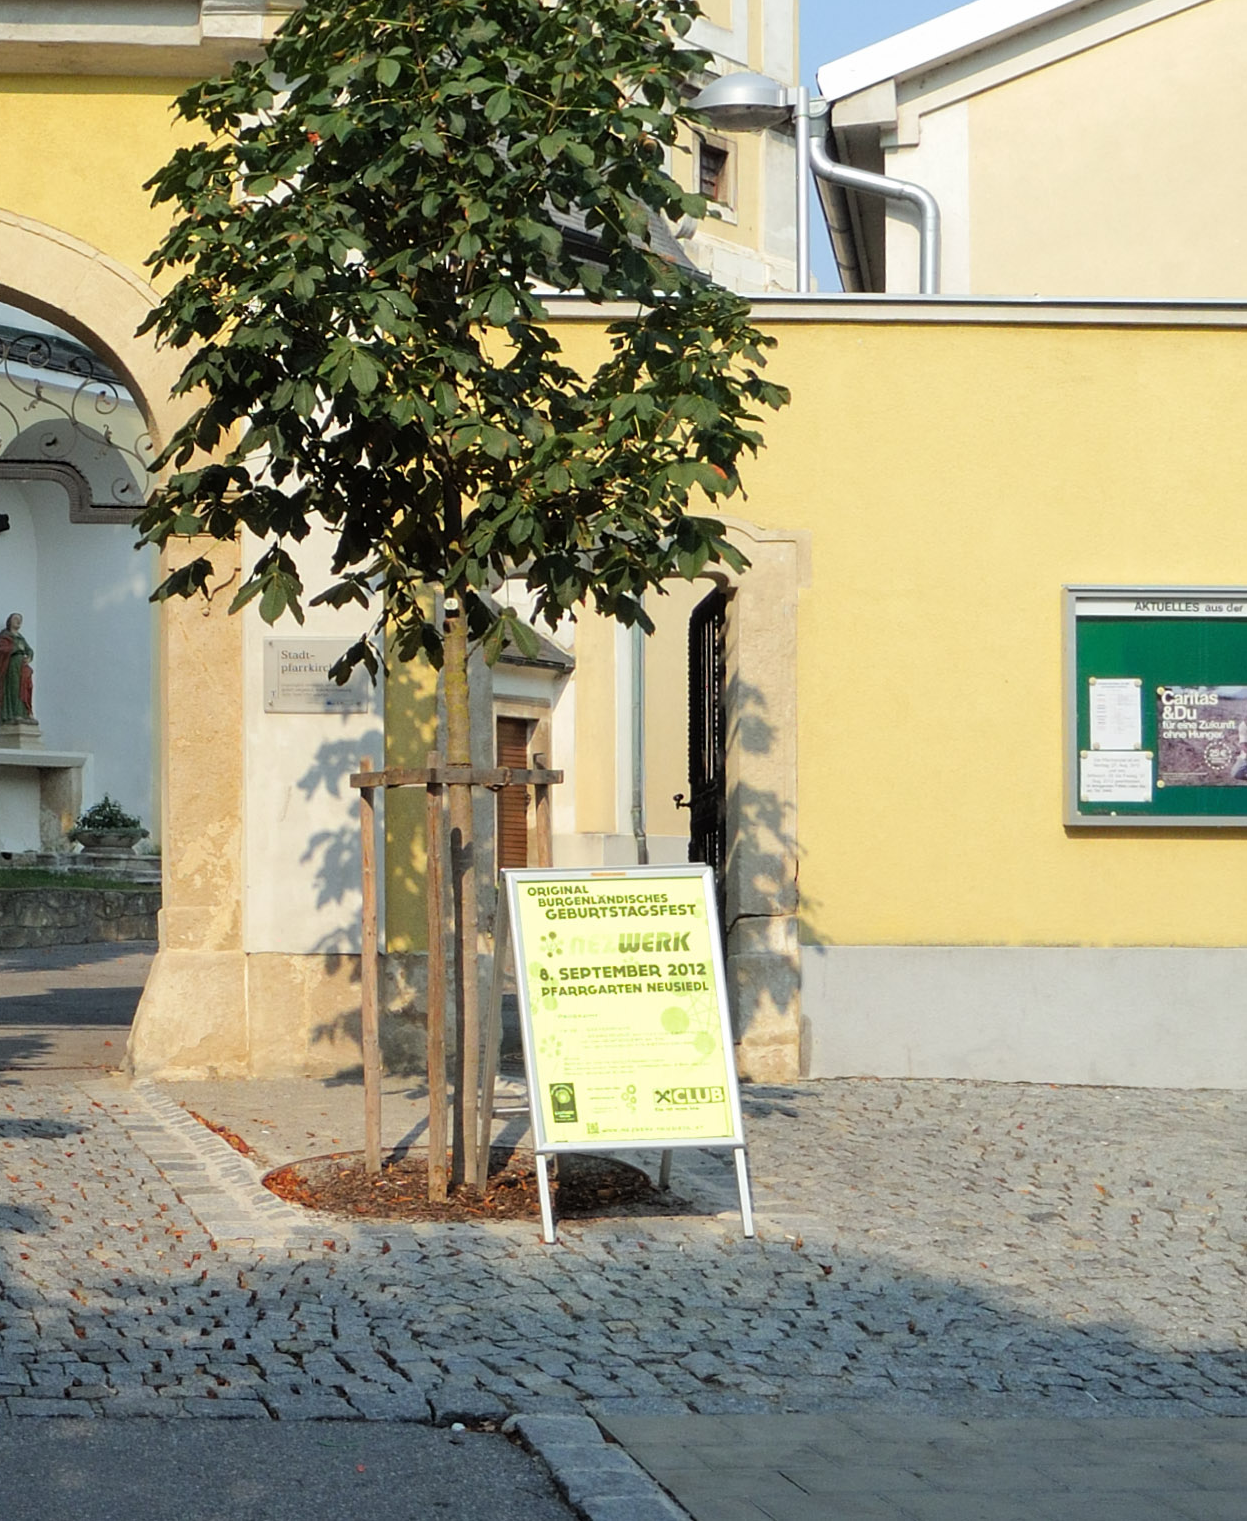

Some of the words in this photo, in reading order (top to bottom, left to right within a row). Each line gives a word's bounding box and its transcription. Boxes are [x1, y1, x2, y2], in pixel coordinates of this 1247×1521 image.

[1134, 602, 1200, 612] AKTUELLES
[1205, 604, 1223, 612] aus
[1226, 603, 1243, 612] der
[281, 650, 315, 659] Stadt-
[281, 662, 332, 674] pfarrkirc
[1162, 690, 1219, 705] Caritas
[1162, 706, 1197, 720] &Du
[1162, 720, 1176, 729] für
[1177, 721, 1197, 729] eine
[1198, 720, 1235, 729] Zukunft
[1163, 730, 1187, 738] ohne
[527, 885, 589, 896] ORIGINAL
[538, 894, 668, 907] BURGENLÄNDISCHES
[545, 904, 696, 920] GEBURTSTAGSFEST
[539, 968, 553, 981] 8.
[559, 964, 662, 980] SEPTEMBER
[668, 963, 706, 976] 2012
[541, 983, 642, 997] PFARRGARTEN
[647, 982, 709, 993] NEUSIEDL
[672, 1087, 724, 1104] CLUB
